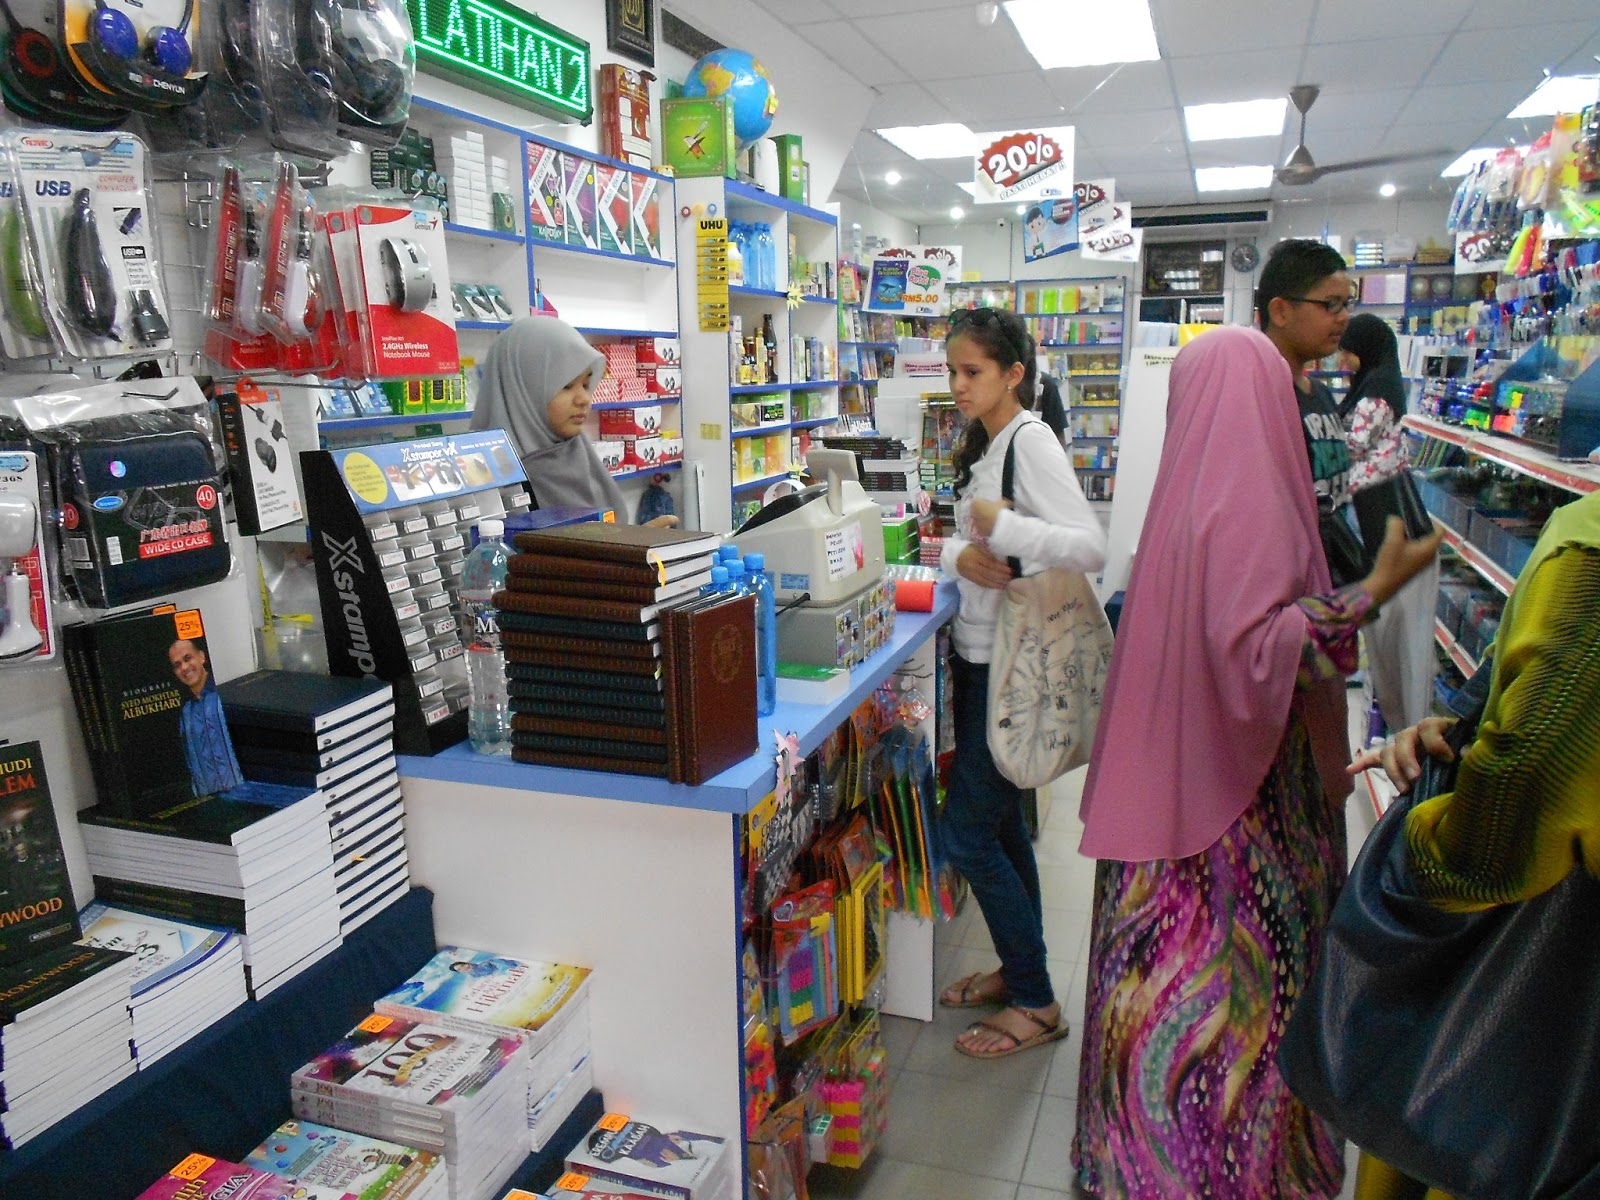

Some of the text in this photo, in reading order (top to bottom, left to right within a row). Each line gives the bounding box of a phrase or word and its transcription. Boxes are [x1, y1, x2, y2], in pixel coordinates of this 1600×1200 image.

[418, 0, 562, 95] LATIHAN
[153, 80, 186, 95] CHENYUN
[988, 135, 1054, 183] 20%
[36, 180, 72, 196] USB
[99, 175, 134, 183] COMPUTER
[1001, 181, 1028, 200] PASTI
[1027, 167, 1058, 189] HEBAT
[414, 223, 431, 231] Genius
[700, 220, 723, 230] UHU
[1089, 233, 1134, 252] 20%
[901, 294, 939, 303] RM5.00
[383, 351, 411, 359] Notebook
[404, 342, 429, 350] Wireless
[198, 490, 213, 502] 40
[144, 535, 210, 555] WIDE CD CASE
[179, 620, 200, 631] 25%
[123, 681, 171, 697] BIOGRAFI
[121, 690, 180, 709] SYED MOKHTAR
[123, 696, 181, 720] ALBUKHARY
[134, 943, 159, 962] 3
[465, 964, 529, 1013] Hikmah
[361, 1032, 457, 1083] 100
[421, 1042, 481, 1093] DILUPAKAN
[618, 1124, 650, 1156] KAABAH
[180, 1157, 207, 1176] 25%
